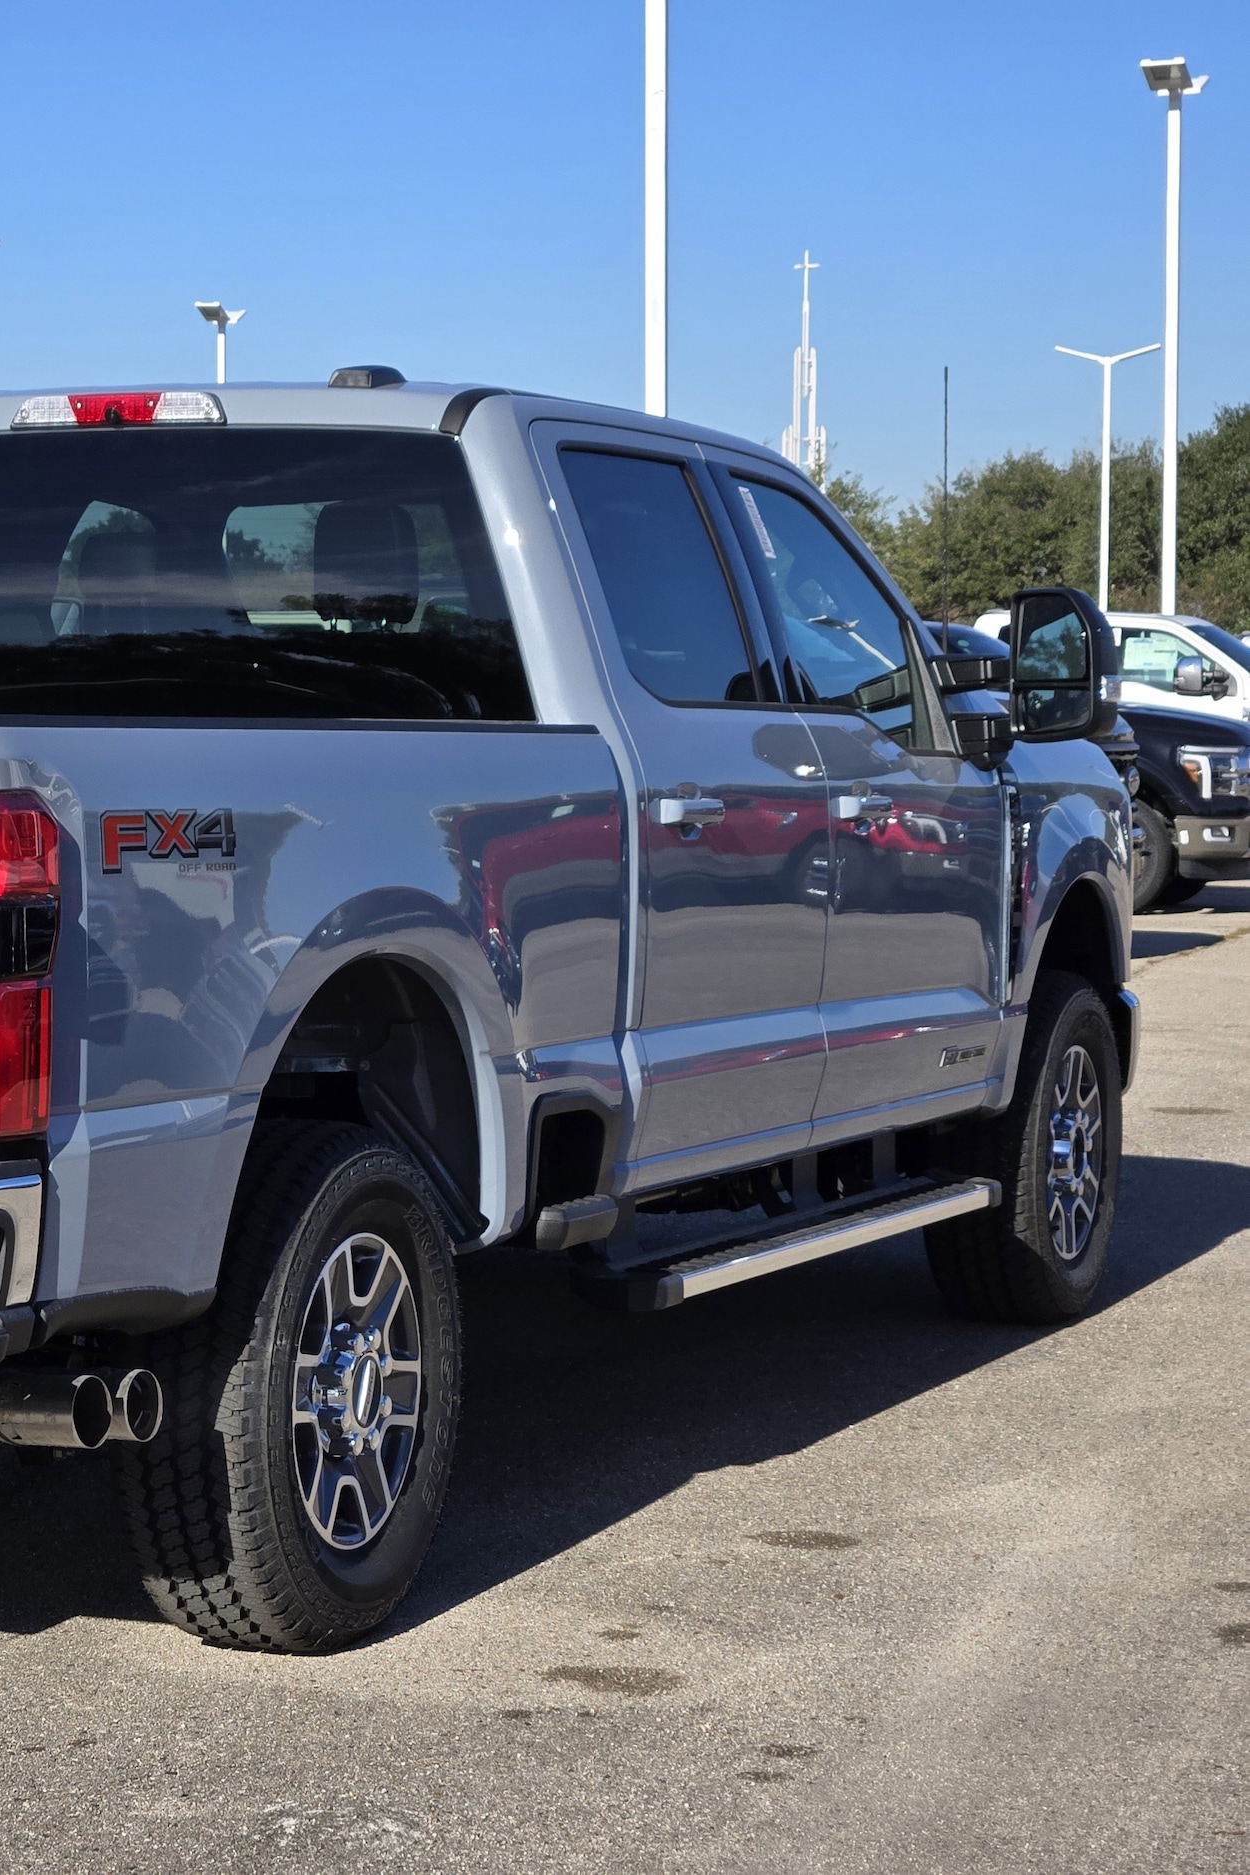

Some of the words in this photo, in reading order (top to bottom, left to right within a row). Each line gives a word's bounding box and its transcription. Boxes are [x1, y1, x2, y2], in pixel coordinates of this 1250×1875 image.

[100, 808, 236, 875] FX4
[178, 863, 201, 873] OFF
[205, 862, 237, 872] ROAD
[403, 1204, 453, 1512] BRIDGESTONE
